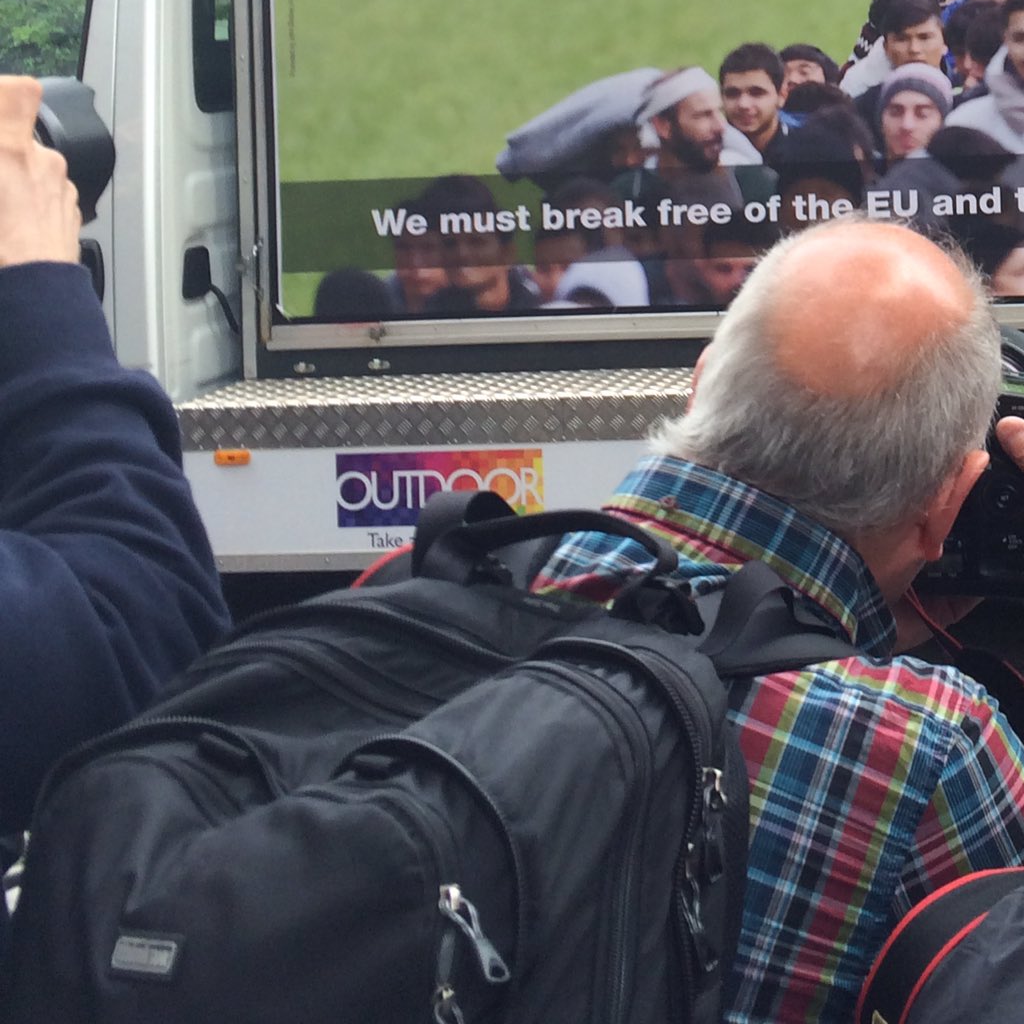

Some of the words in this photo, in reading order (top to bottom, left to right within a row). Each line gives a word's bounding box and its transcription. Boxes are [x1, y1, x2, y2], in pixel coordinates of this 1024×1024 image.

[371, 207, 428, 236] We
[440, 204, 531, 234] must
[542, 200, 648, 231] break
[657, 198, 732, 226] free
[744, 194, 782, 223] of
[791, 193, 854, 221] the
[866, 189, 919, 218] EU
[932, 186, 1001, 216] and
[367, 532, 404, 548] Take
